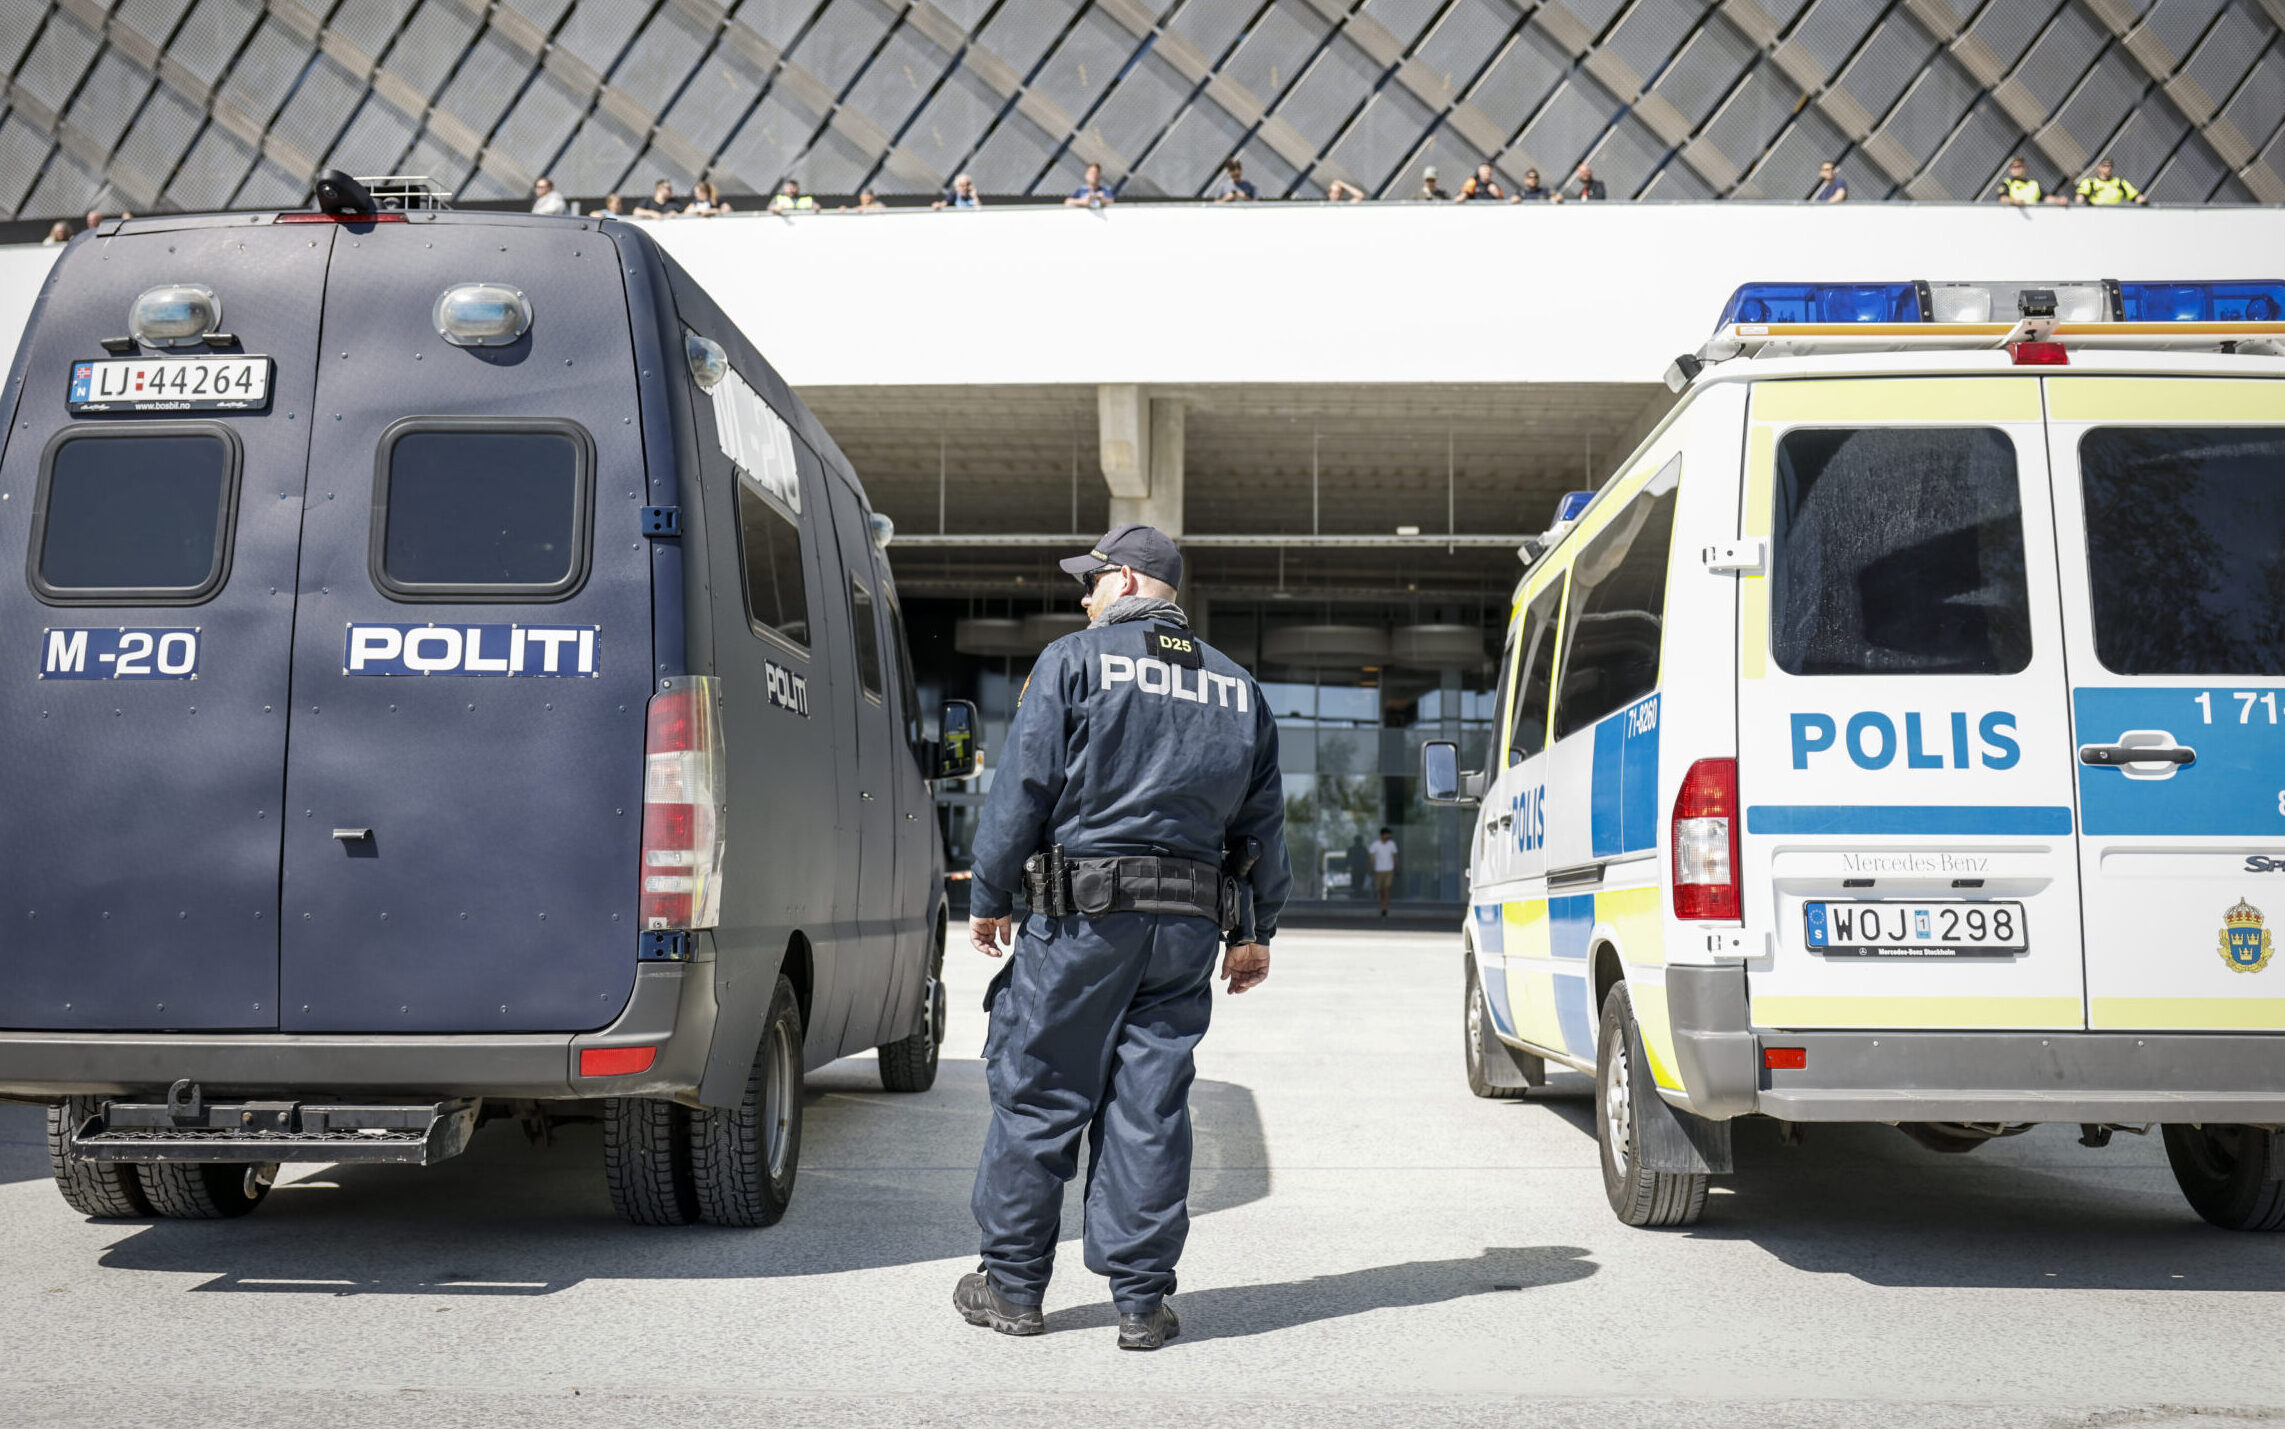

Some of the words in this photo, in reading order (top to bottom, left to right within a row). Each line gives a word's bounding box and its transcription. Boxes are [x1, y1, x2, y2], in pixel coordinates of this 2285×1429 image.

[76, 387, 86, 396] N
[100, 366, 129, 396] LJ
[149, 365, 252, 394] 44264
[349, 627, 594, 673] POLITI
[1159, 635, 1192, 653] D25
[765, 662, 808, 715] POLITI
[1100, 653, 1248, 713] POLITI
[1628, 697, 1658, 739] 71-8260
[2233, 691, 2285, 725] 71
[1790, 710, 2021, 771] POLIS
[1512, 783, 1545, 853] POLIS
[1814, 929, 1822, 939] S
[1833, 908, 1907, 941] WOJ
[1940, 908, 2014, 941] 298
